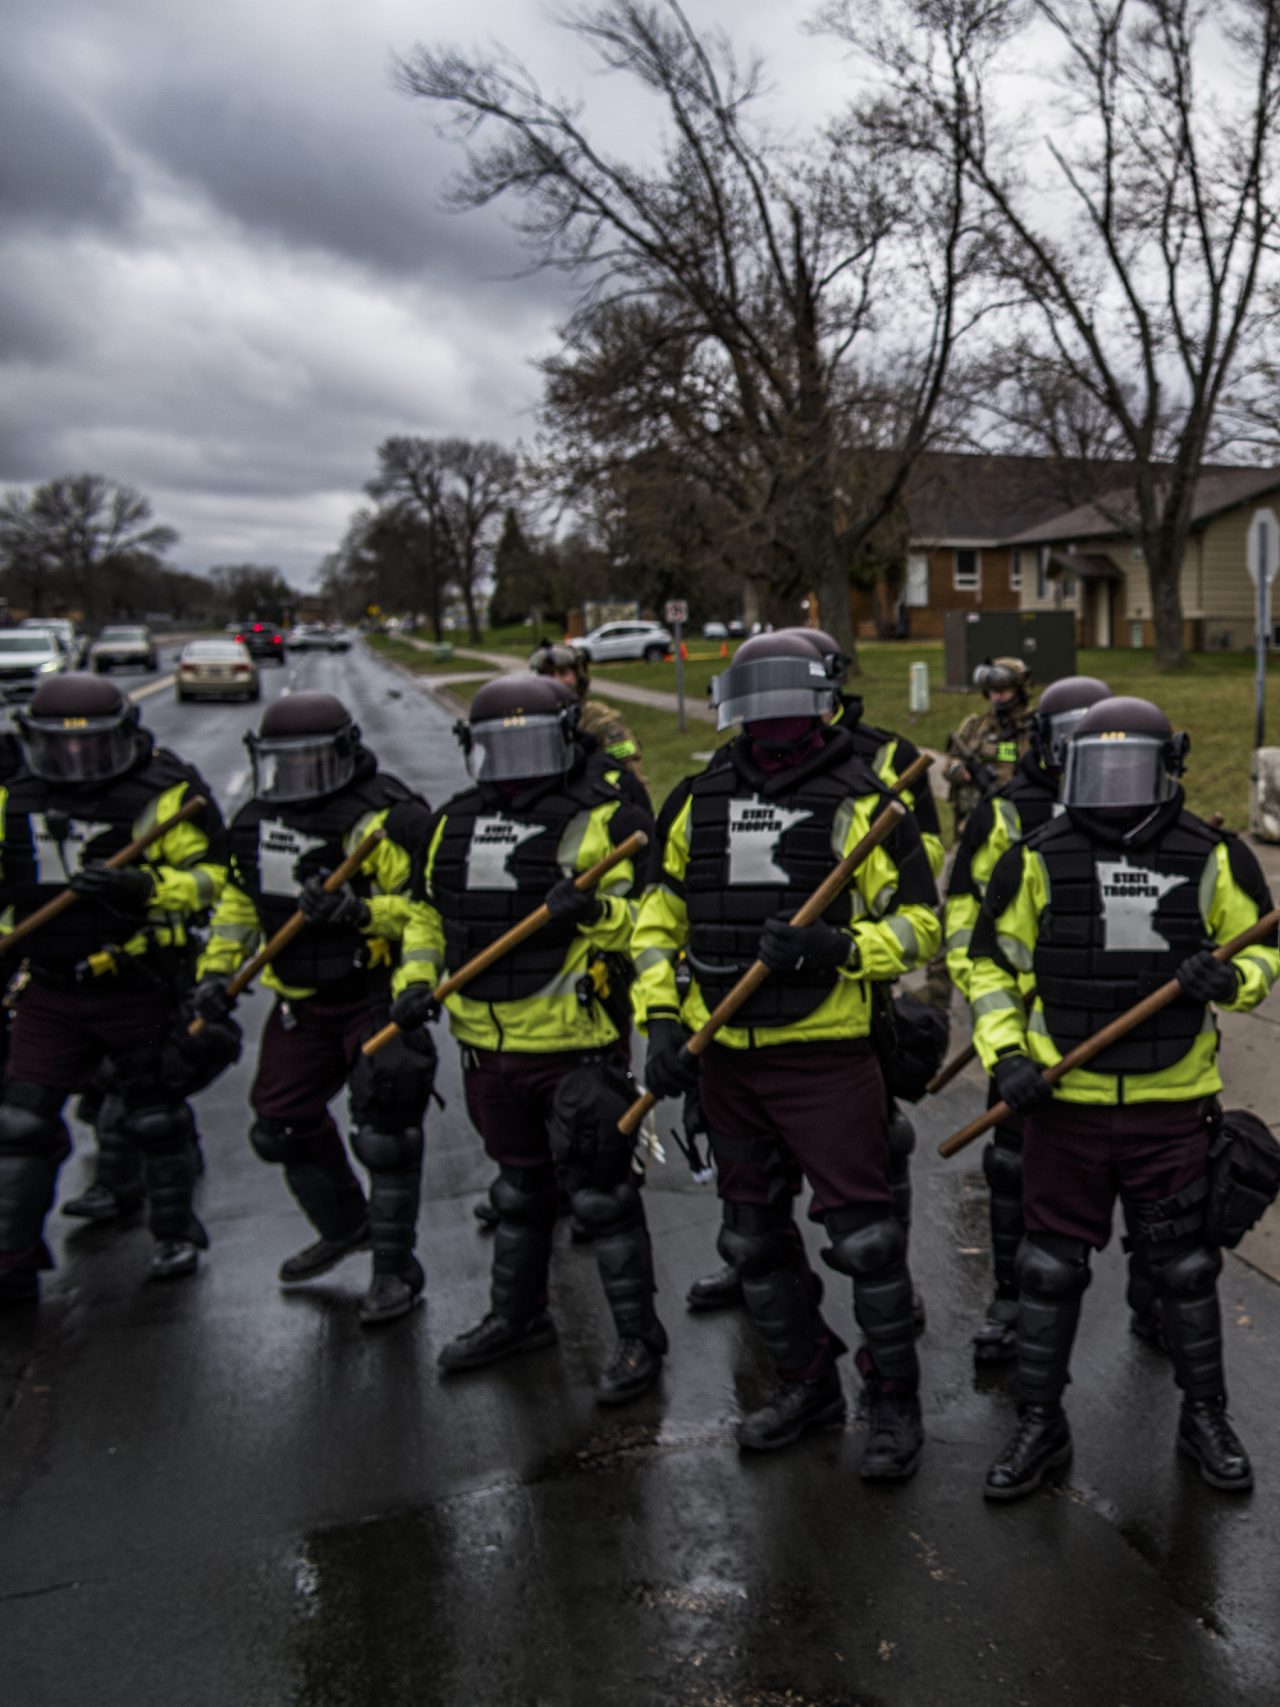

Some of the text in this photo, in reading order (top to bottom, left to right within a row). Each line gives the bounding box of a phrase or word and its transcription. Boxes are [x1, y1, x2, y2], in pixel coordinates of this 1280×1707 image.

[742, 808, 775, 820] STATE
[484, 824, 514, 835] STATE
[731, 820, 783, 833] TROOPER
[474, 835, 518, 846] TROOPER
[1113, 872, 1149, 884] STATE
[1103, 885, 1159, 898] TROOPER
